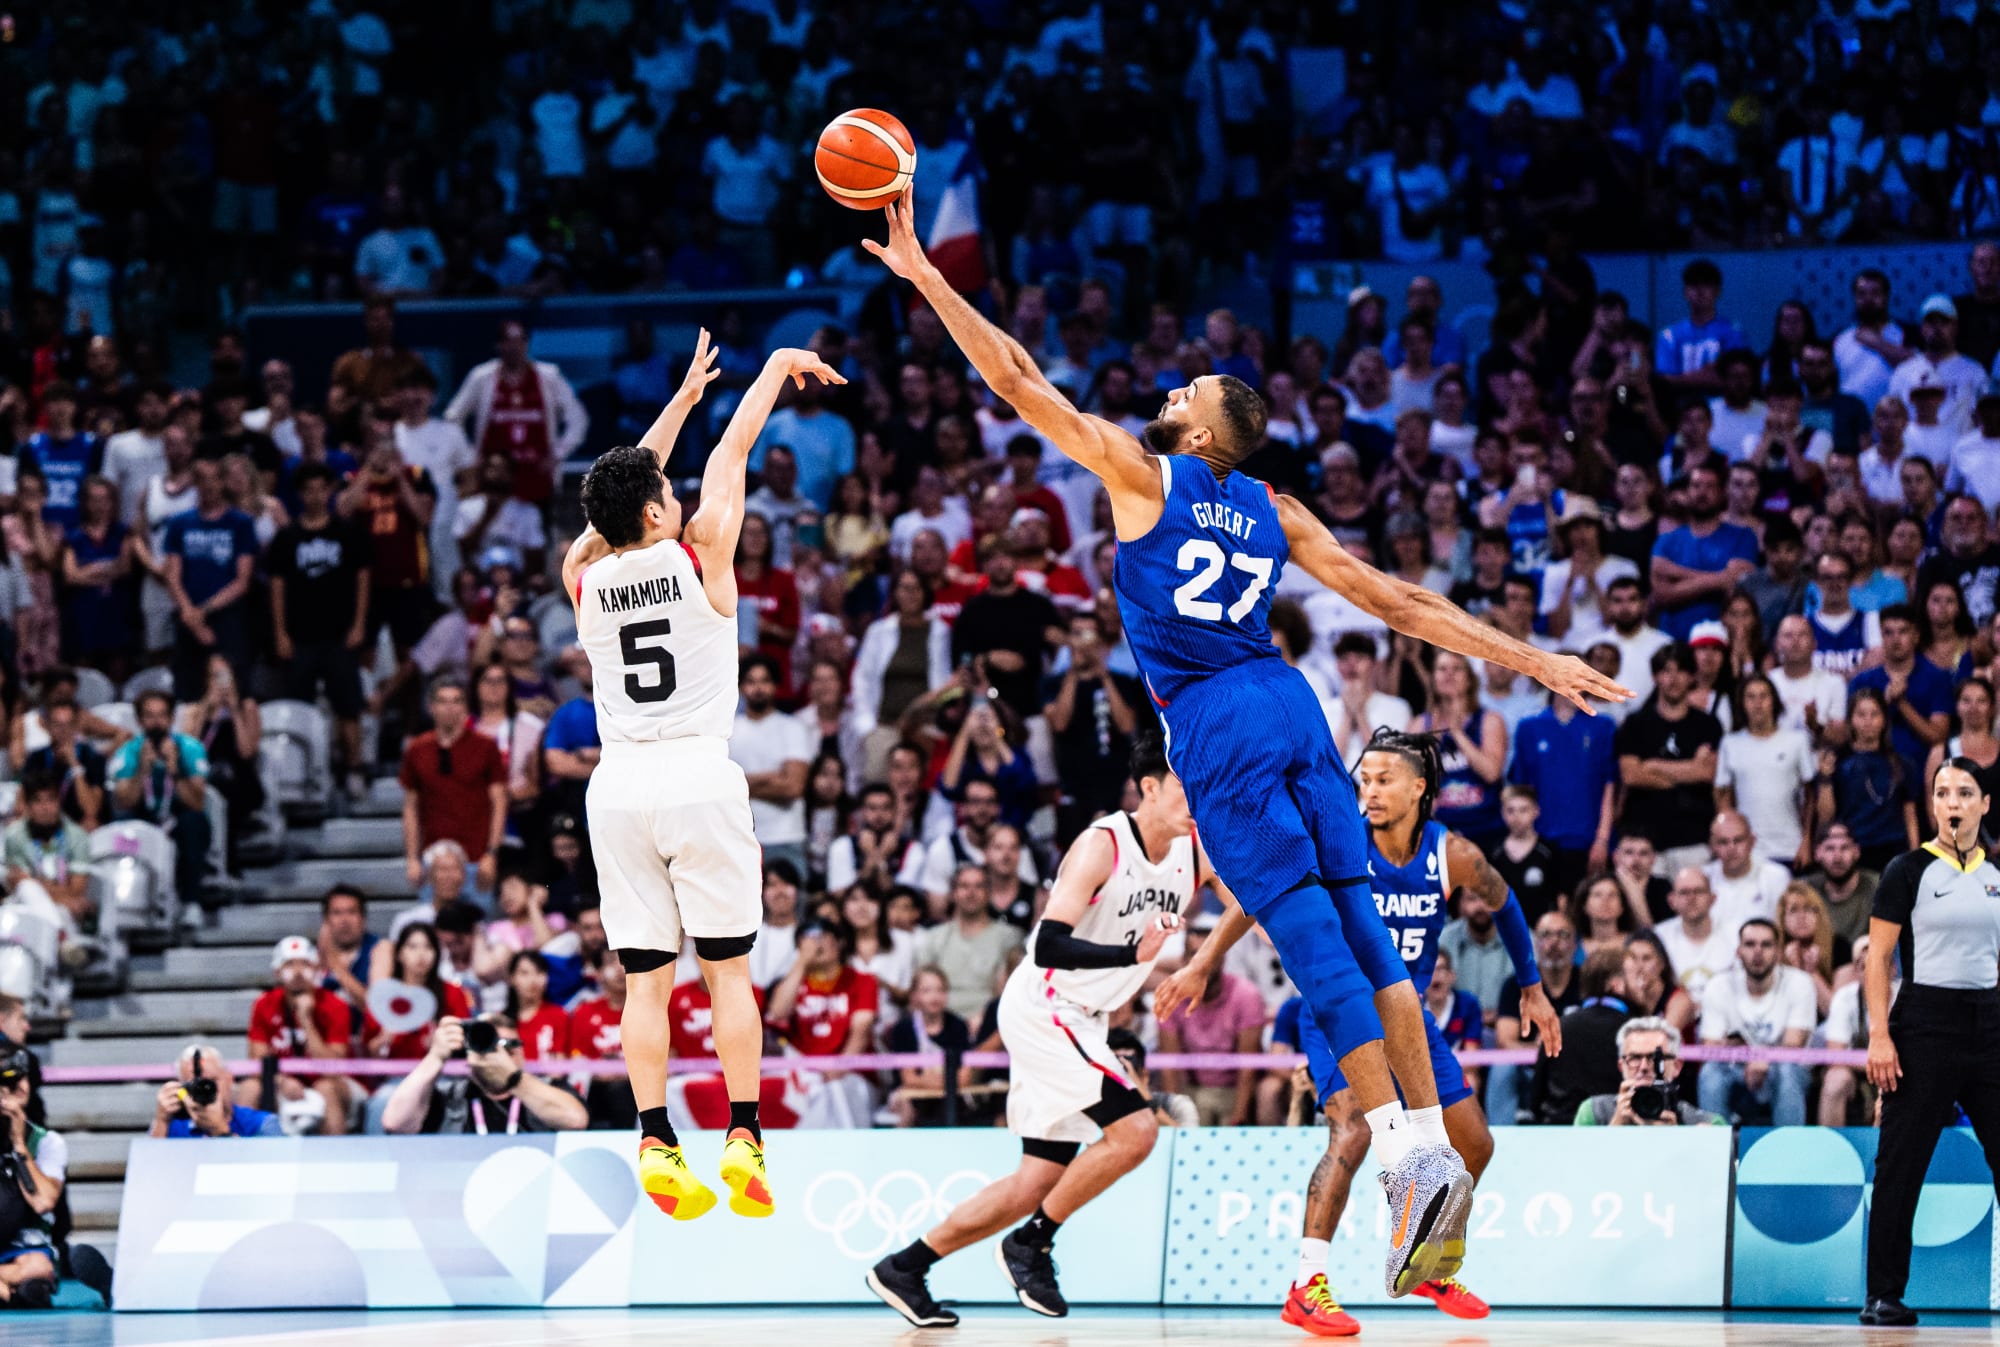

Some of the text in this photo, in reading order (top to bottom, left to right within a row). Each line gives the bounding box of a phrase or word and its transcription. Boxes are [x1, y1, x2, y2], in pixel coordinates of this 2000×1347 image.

[1191, 502, 1257, 540] GOBERT
[598, 575, 682, 613] KAWAMURA
[1174, 538, 1274, 624] 27
[619, 618, 677, 703] 5
[1118, 888, 1181, 917] JAPAN
[1371, 893, 1441, 917] RANCE
[1217, 1191, 1676, 1239] PAI 2024
